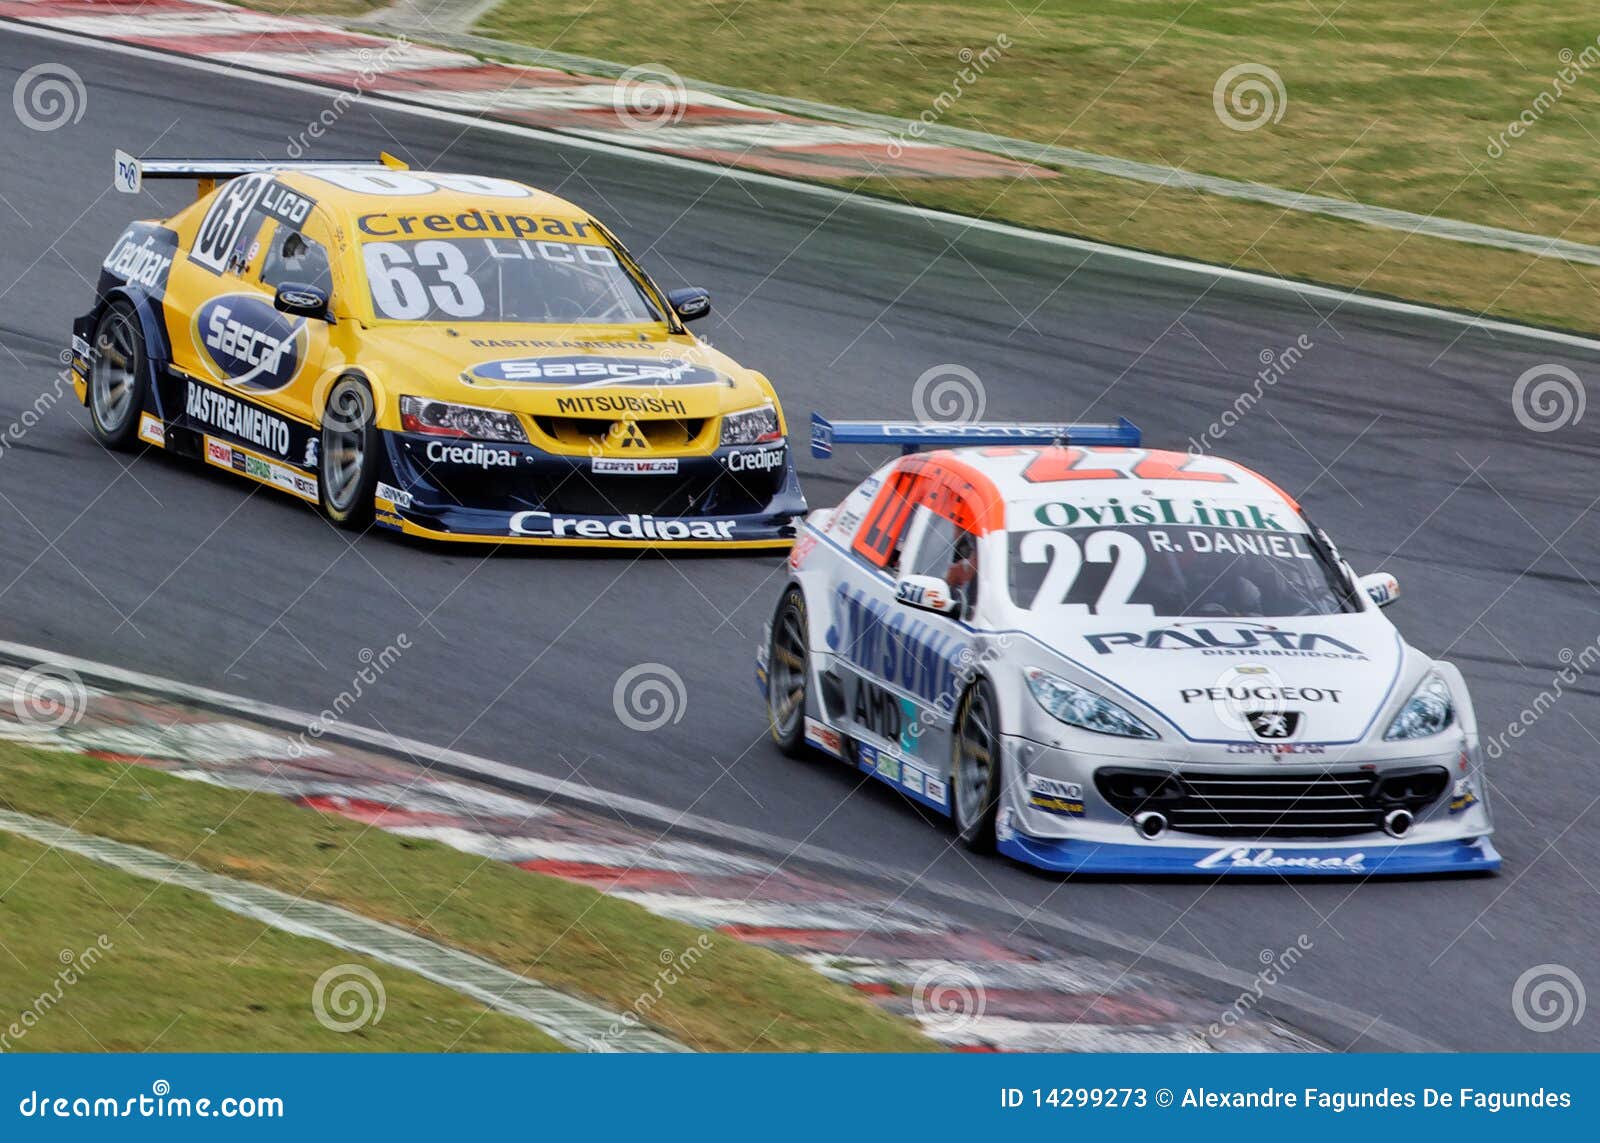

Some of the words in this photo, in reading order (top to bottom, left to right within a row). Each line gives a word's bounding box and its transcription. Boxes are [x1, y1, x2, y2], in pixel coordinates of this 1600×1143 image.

[261, 184, 311, 223] LICO
[358, 210, 591, 239] Credipar
[103, 230, 172, 288] Credipar
[362, 240, 485, 320] 63
[484, 238, 619, 267] LICO
[206, 304, 293, 376] Sascar
[470, 338, 655, 351] RASTREAMENTO
[501, 360, 696, 382] Sascar
[186, 380, 290, 456] RASTREAMENTO
[556, 396, 687, 416] MITSUBISHI
[426, 441, 518, 470] Credipar
[728, 447, 784, 472] Credipar
[509, 510, 736, 541] Credipar
[1035, 497, 1288, 531] OvisLink
[1020, 530, 1154, 617] 22
[1149, 530, 1181, 553] R.
[1192, 531, 1313, 560] DANIEL
[1085, 626, 1366, 655] PAUTA
[1202, 649, 1371, 662] DISTRIBUIDORA
[1180, 687, 1342, 705] PEUGEOT
